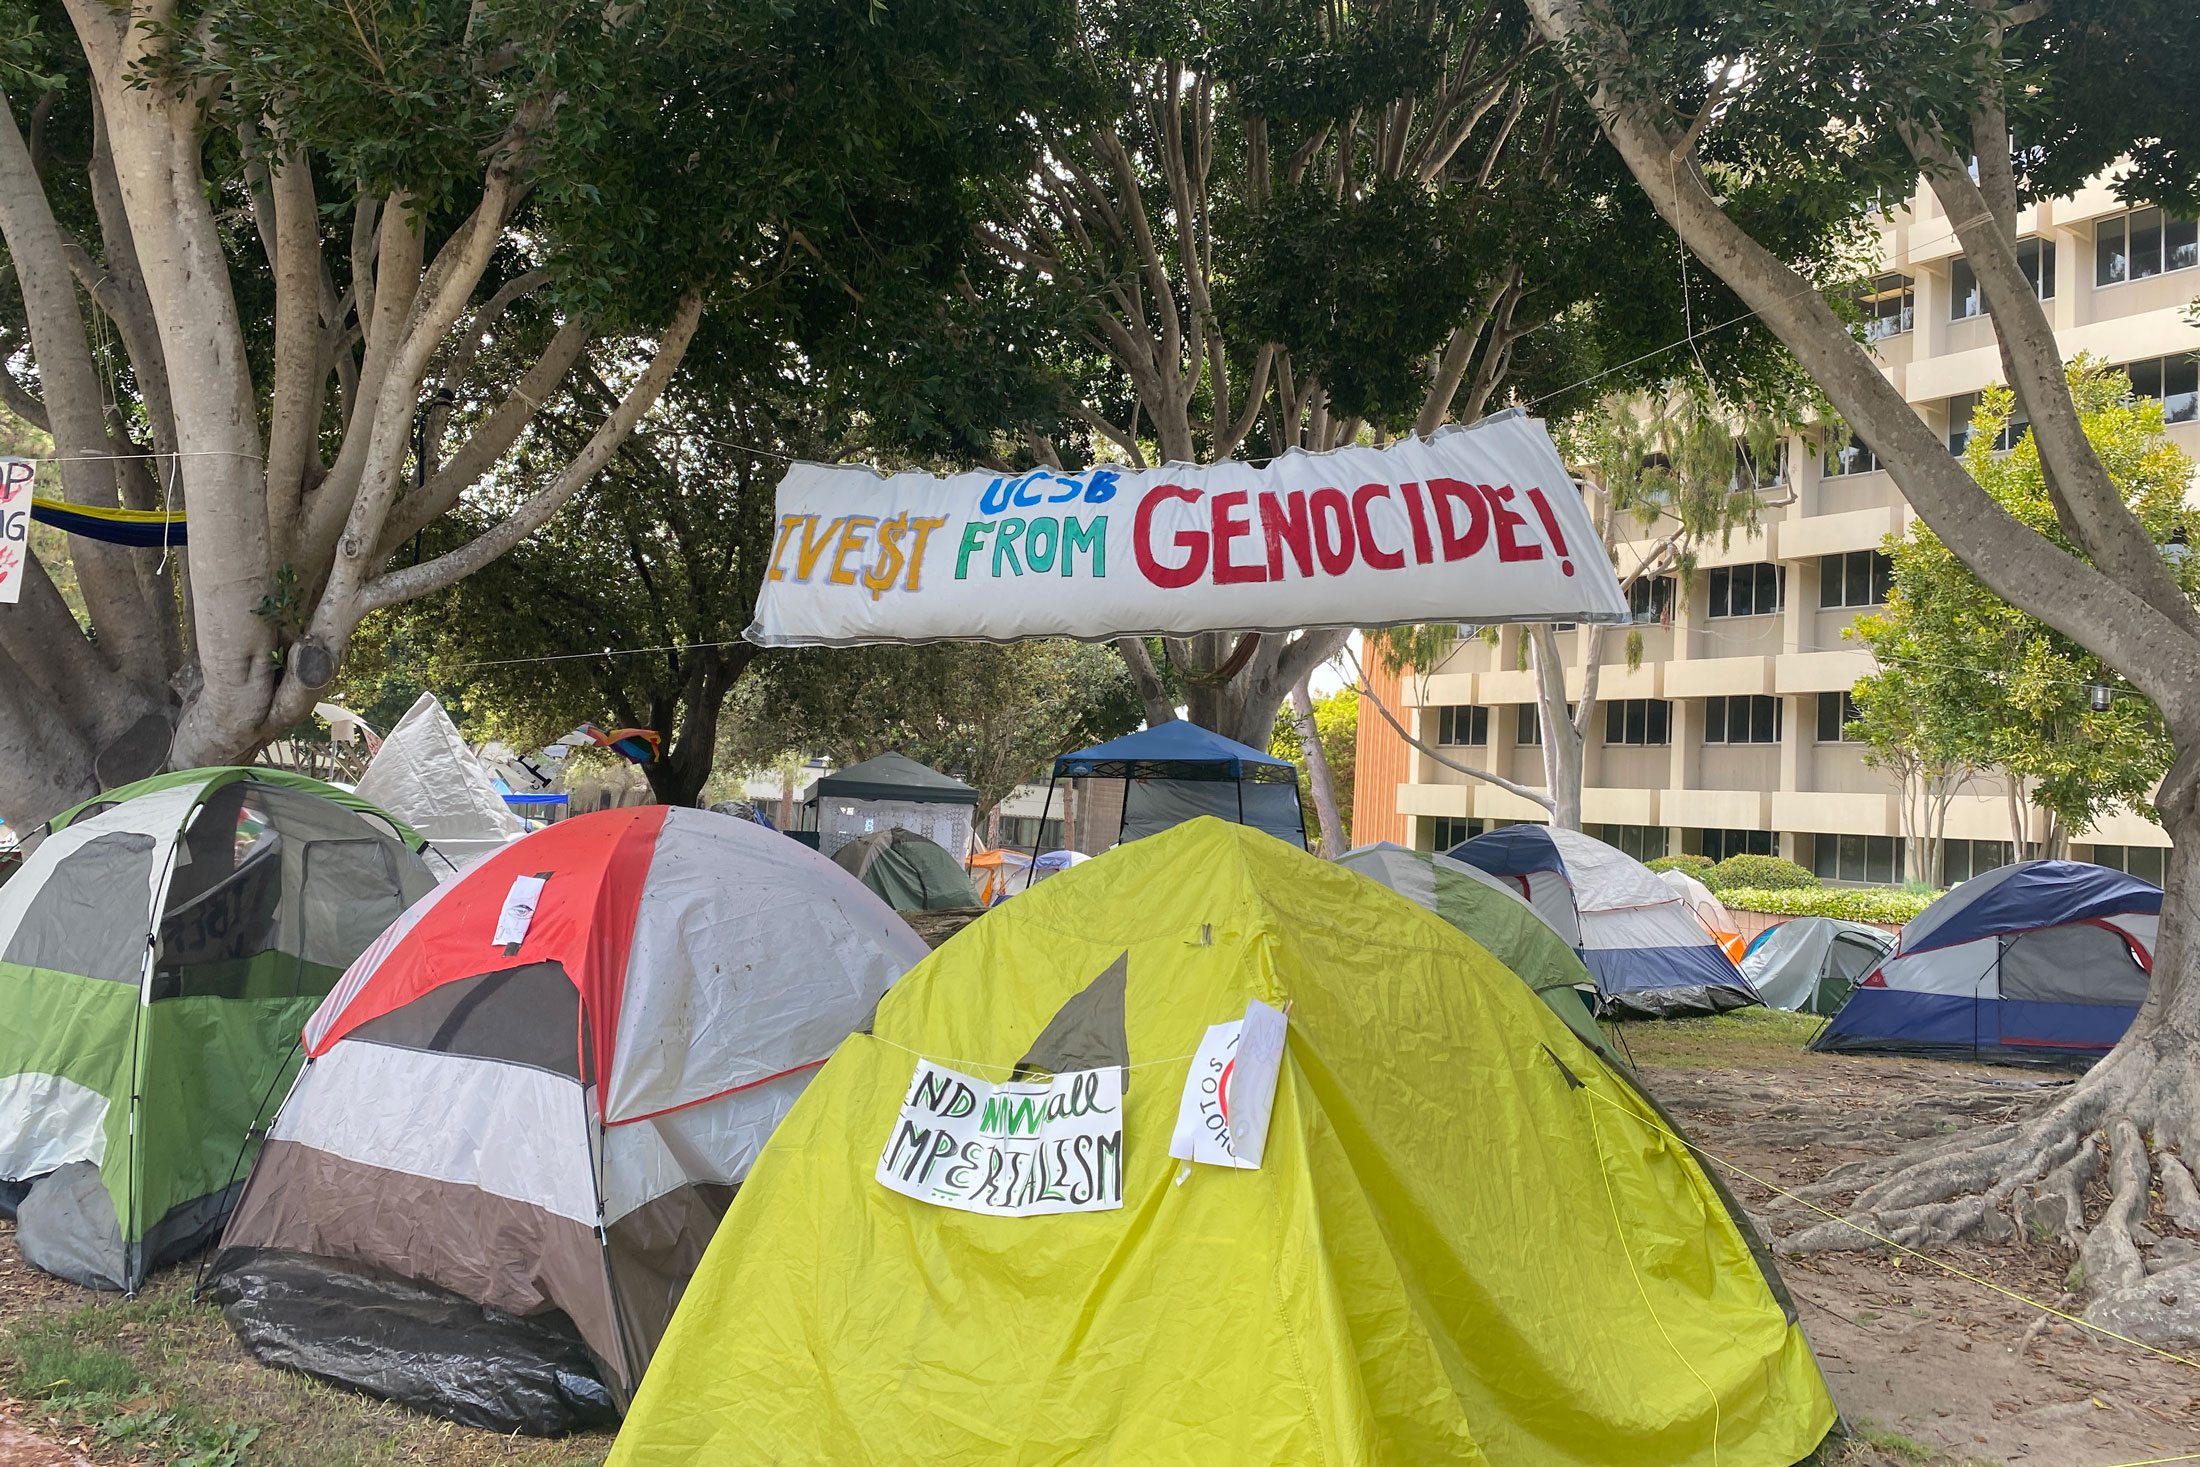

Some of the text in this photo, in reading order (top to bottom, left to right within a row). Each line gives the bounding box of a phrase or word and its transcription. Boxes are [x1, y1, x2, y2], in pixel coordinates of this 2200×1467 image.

[0, 461, 34, 502] P
[980, 470, 1122, 516] UCSB
[955, 515, 1109, 580] FROM
[1132, 477, 1575, 590] GENOCIDE!
[904, 1069, 977, 1118] ND
[884, 1120, 1122, 1208] MPERIALISM
